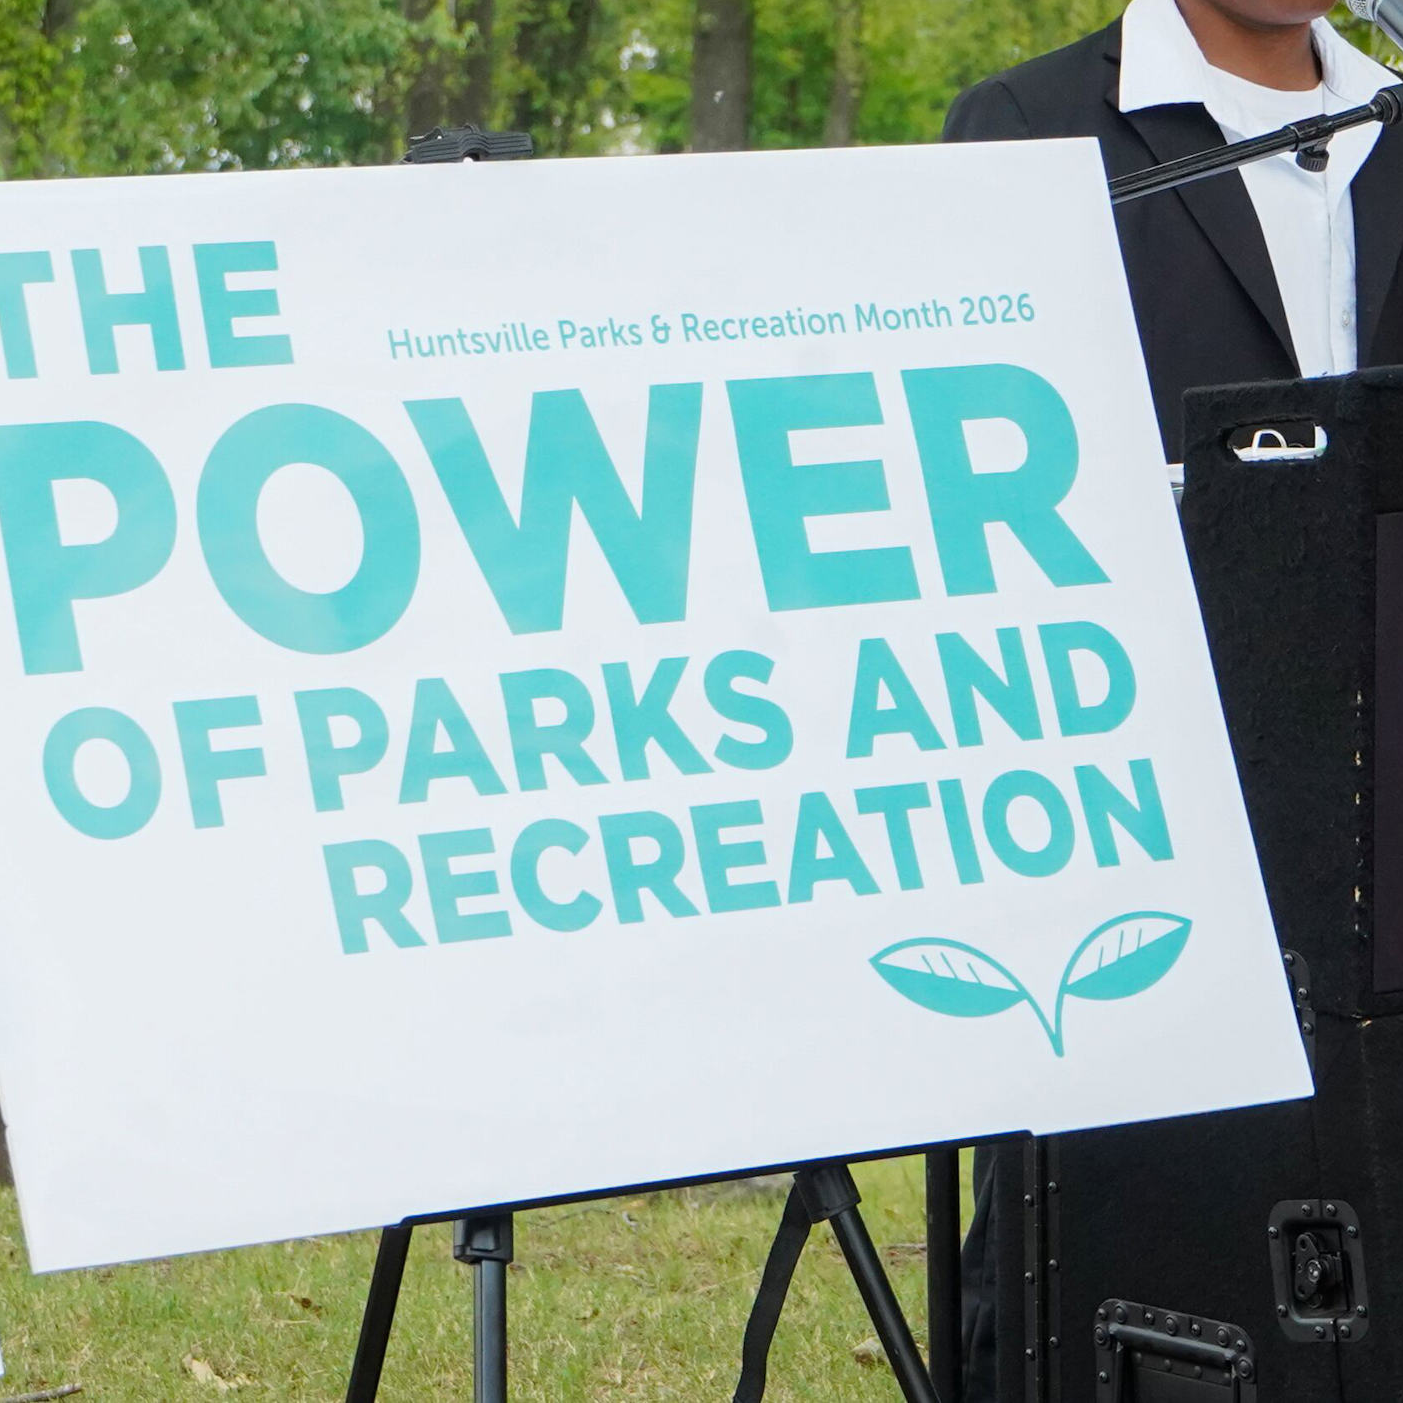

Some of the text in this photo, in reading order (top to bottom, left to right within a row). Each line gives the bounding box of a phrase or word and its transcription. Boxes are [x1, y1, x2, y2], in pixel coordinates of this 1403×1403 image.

[388, 293, 1036, 359] Huntsville Parks & Recreation Month 2026
[42, 620, 1138, 841] OF PARKS AND
[323, 758, 1175, 955] RECREATION
